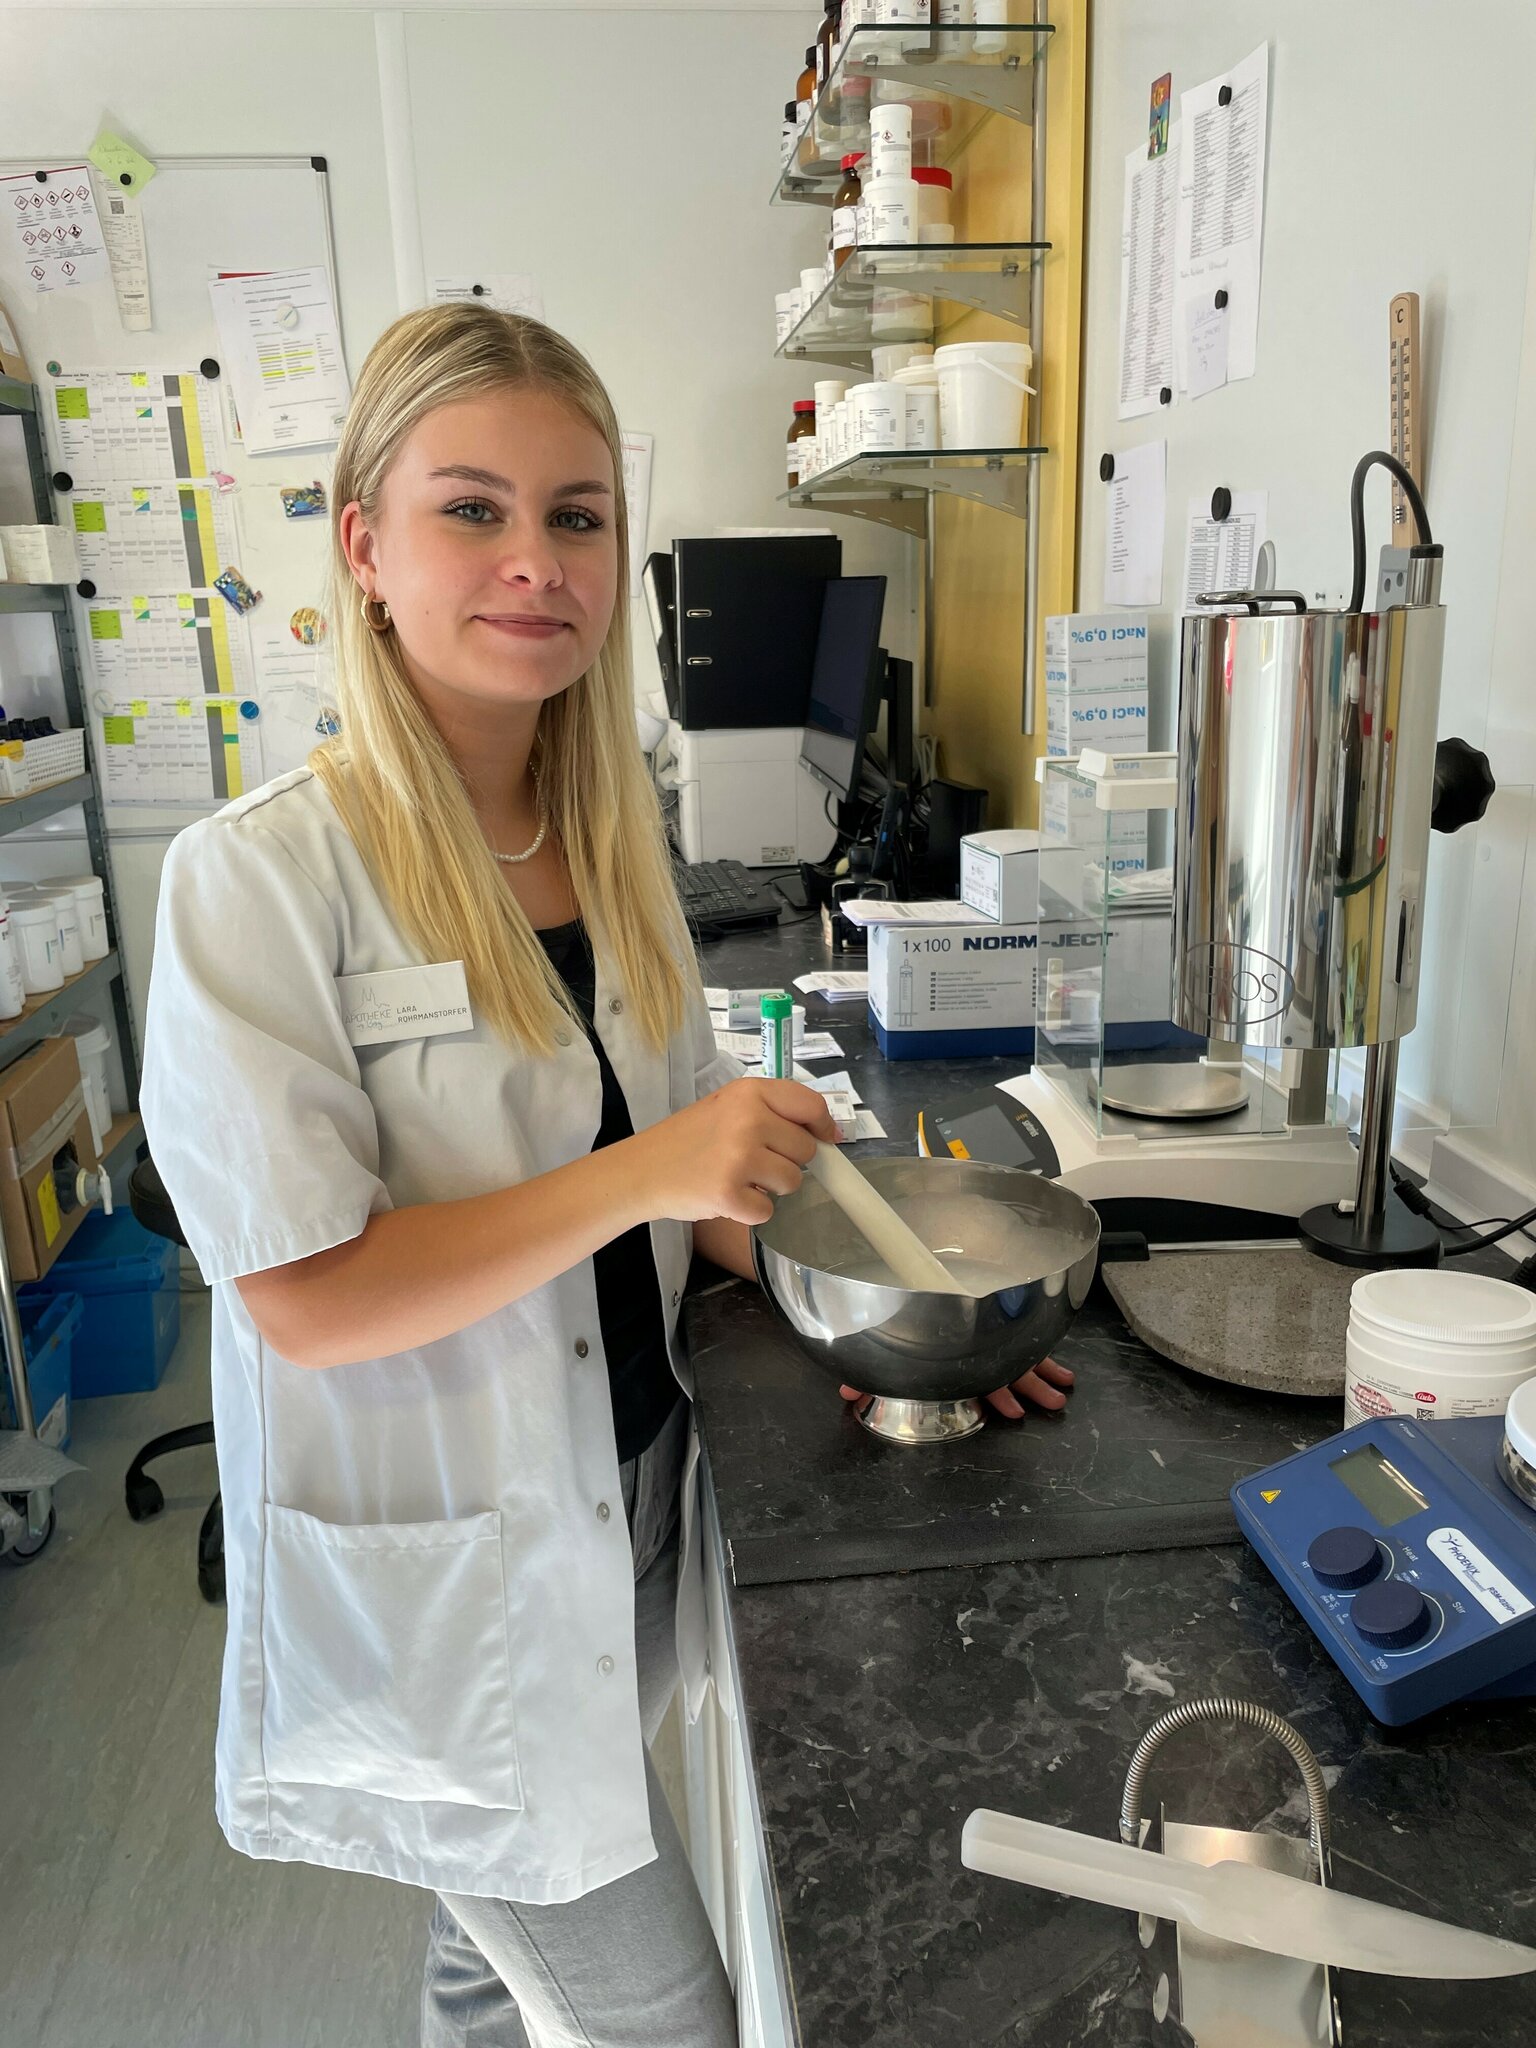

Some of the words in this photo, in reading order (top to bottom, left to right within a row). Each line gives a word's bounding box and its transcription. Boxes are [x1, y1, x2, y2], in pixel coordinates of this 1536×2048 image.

[1071, 628, 1107, 644] 0,9%
[1112, 627, 1146, 640] NaCl
[1072, 708, 1107, 722] 0,9%
[1112, 706, 1146, 719] NaCl
[397, 1006, 417, 1014] LARA
[398, 1008, 467, 1023] ROHRMANSTORFER
[1402, 1546, 1418, 1562] Heat
[1448, 1546, 1480, 1576] PHOENIX
[1452, 1601, 1466, 1614] Stir
[1376, 1656, 1389, 1670] 1500
